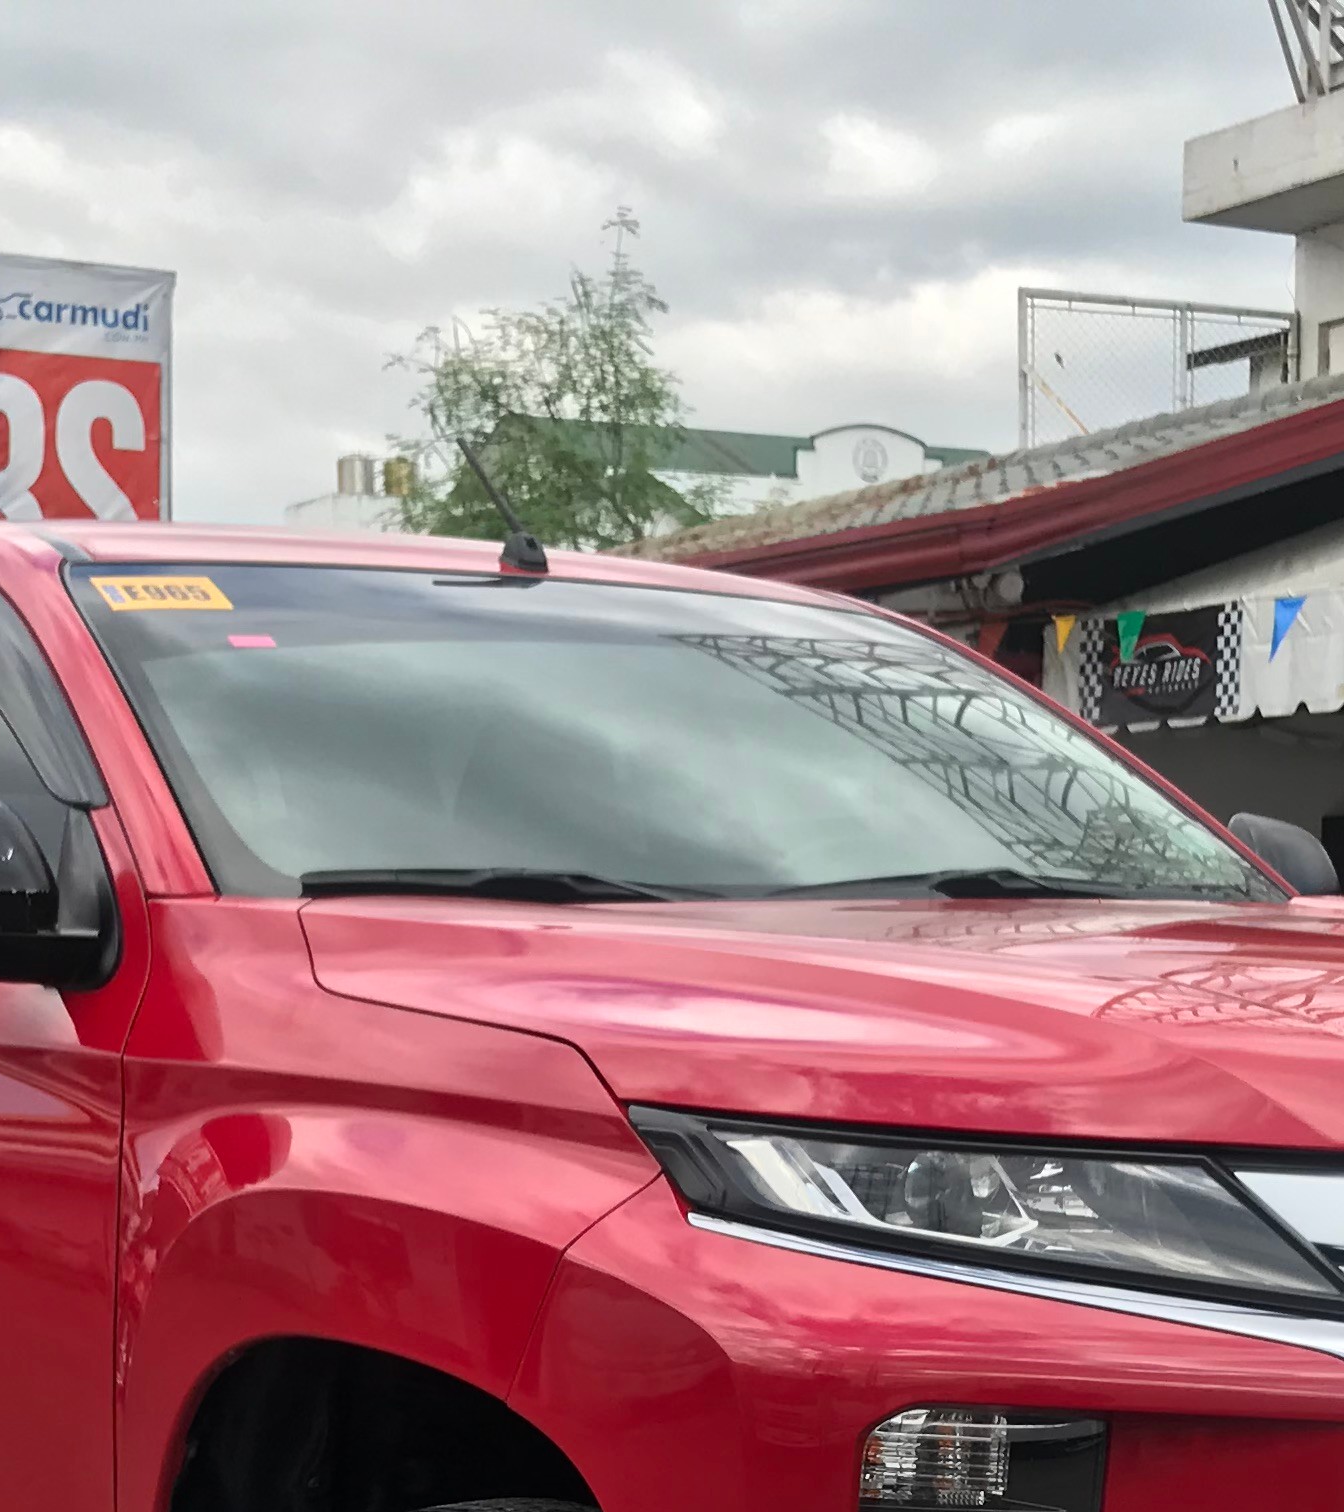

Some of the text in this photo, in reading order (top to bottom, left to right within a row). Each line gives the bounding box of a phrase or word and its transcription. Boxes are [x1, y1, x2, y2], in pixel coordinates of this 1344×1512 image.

[18, 299, 149, 333] carmudi
[1113, 663, 1157, 687] REYES
[1161, 657, 1201, 682] RIDES
